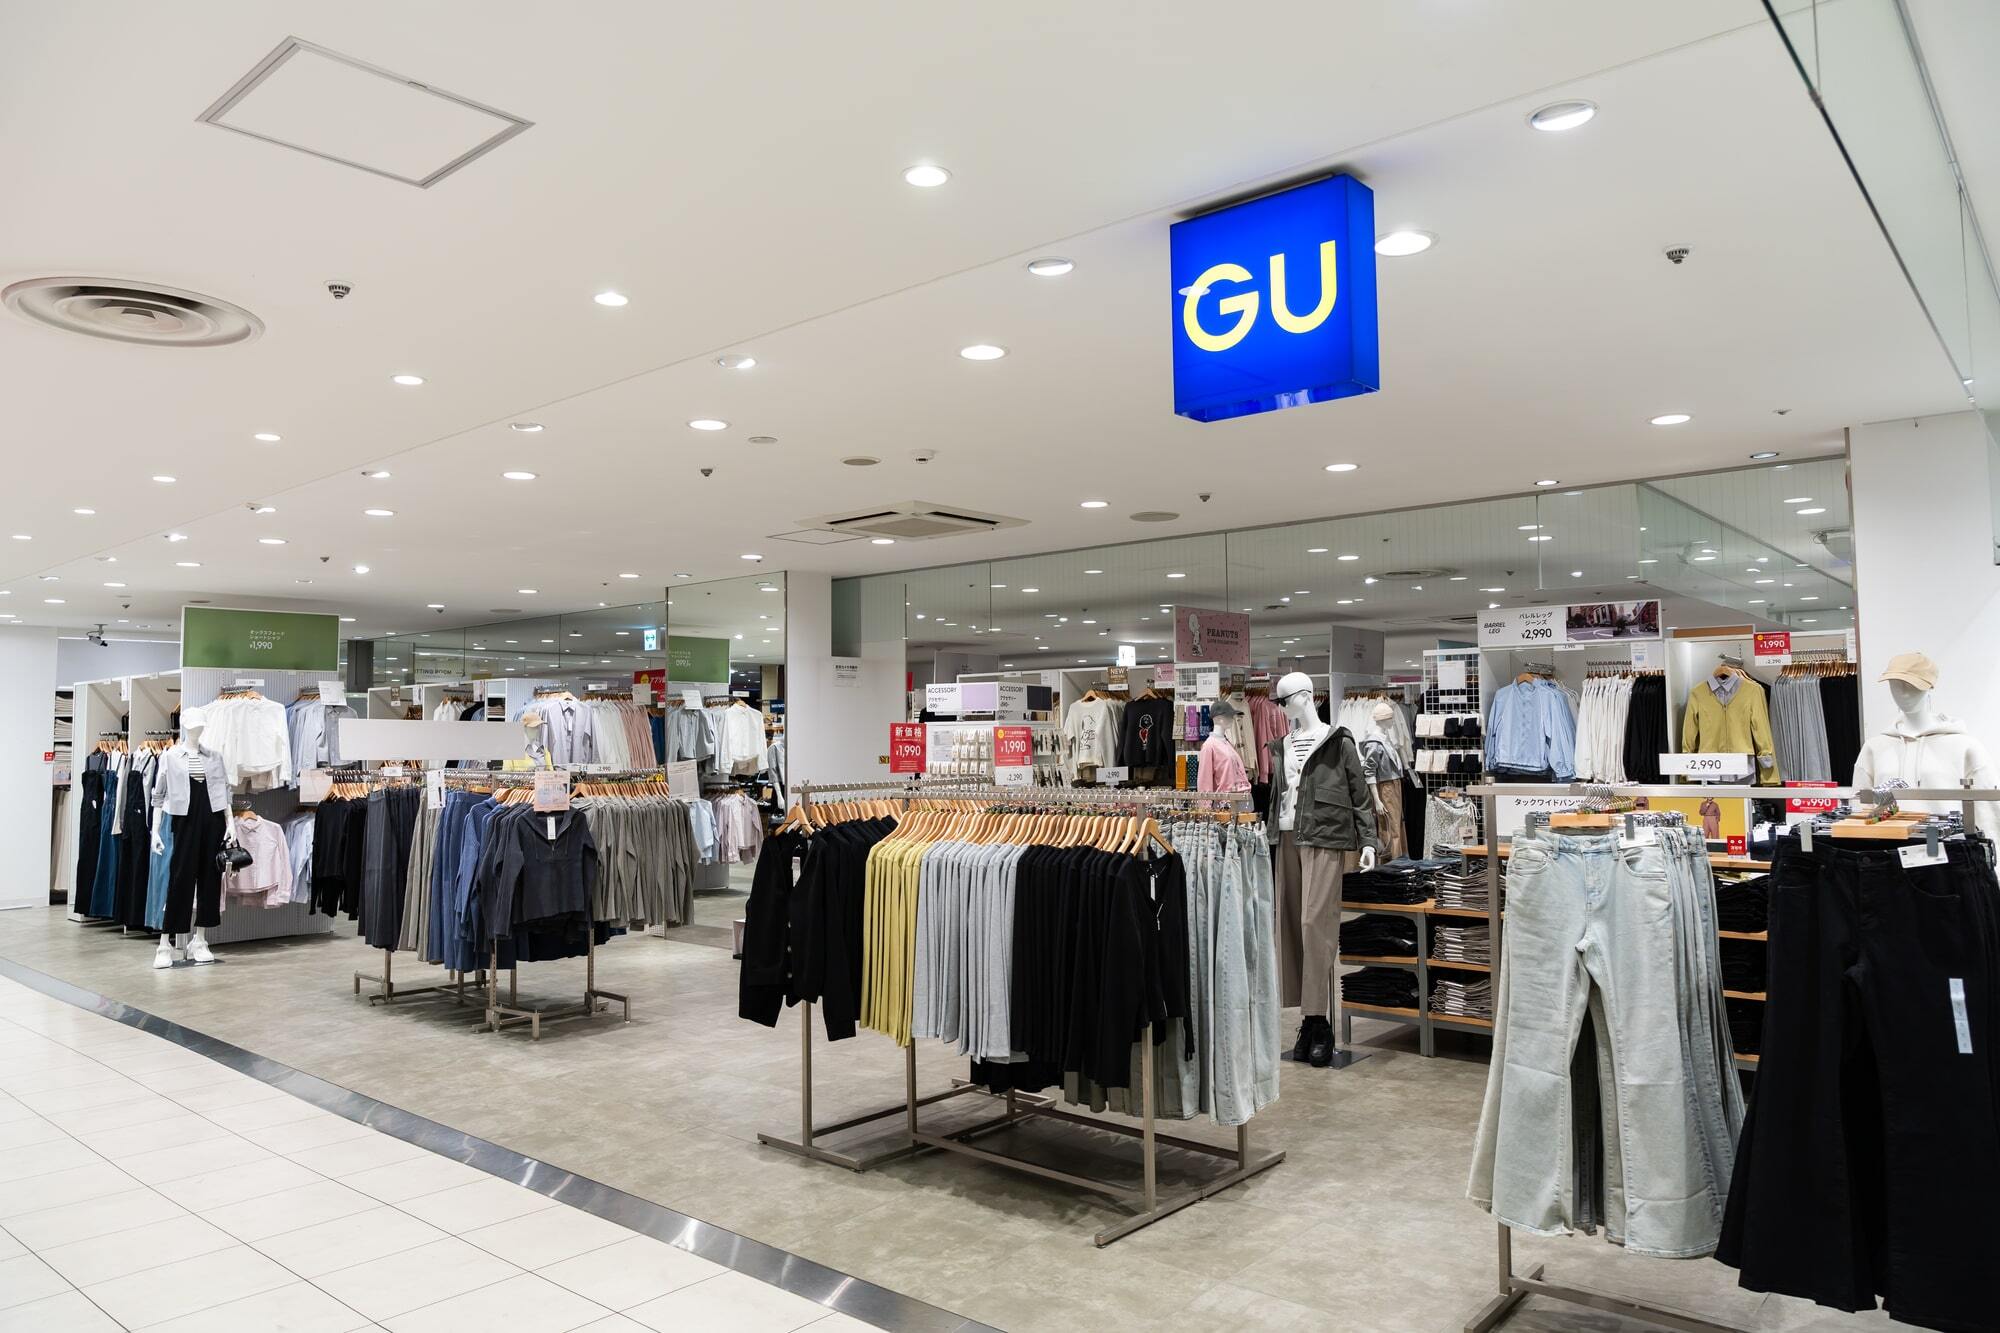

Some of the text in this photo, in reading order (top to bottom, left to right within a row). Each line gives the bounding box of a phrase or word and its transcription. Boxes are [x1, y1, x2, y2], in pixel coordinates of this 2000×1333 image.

[1184, 240, 1337, 352] GU
[1207, 628, 1239, 639] PEANUTS
[1521, 628, 1552, 640] ¥2,990
[250, 641, 273, 650] ¥1,990
[1760, 640, 1785, 649] ¥1,990
[895, 726, 921, 737] 新価格
[895, 744, 921, 757] ¥1,990
[1001, 740, 1026, 755] ¥1,990
[1686, 760, 1721, 770] ¥2,990
